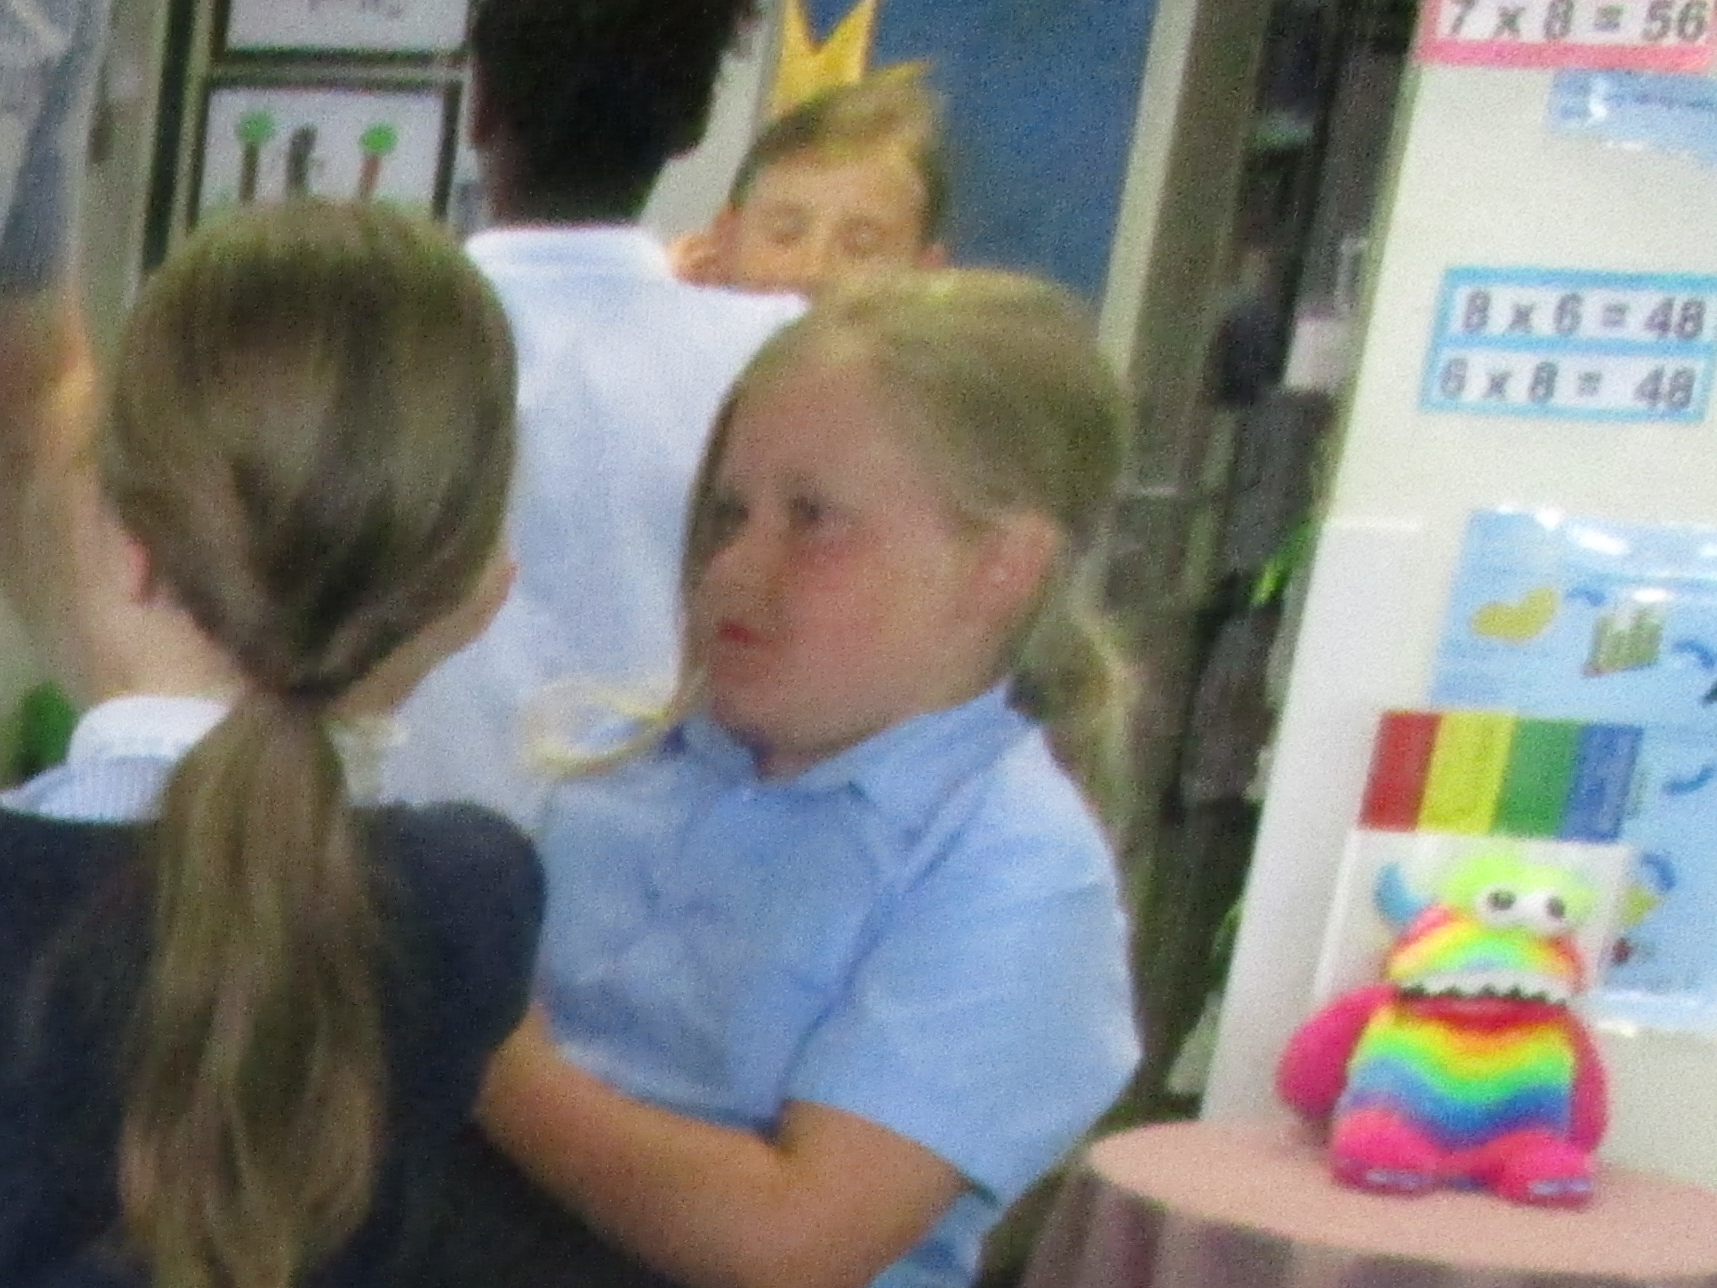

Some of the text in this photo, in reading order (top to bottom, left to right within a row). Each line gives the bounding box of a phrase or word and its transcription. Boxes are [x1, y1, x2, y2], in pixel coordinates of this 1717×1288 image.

[1447, 0, 1479, 36] 7
[1643, 0, 1708, 41] 56
[1463, 289, 1491, 333] 8
[1554, 292, 1584, 336] 6
[1645, 297, 1706, 341] 48
[1528, 360, 1560, 404] 8
[1635, 366, 1697, 411] 48
